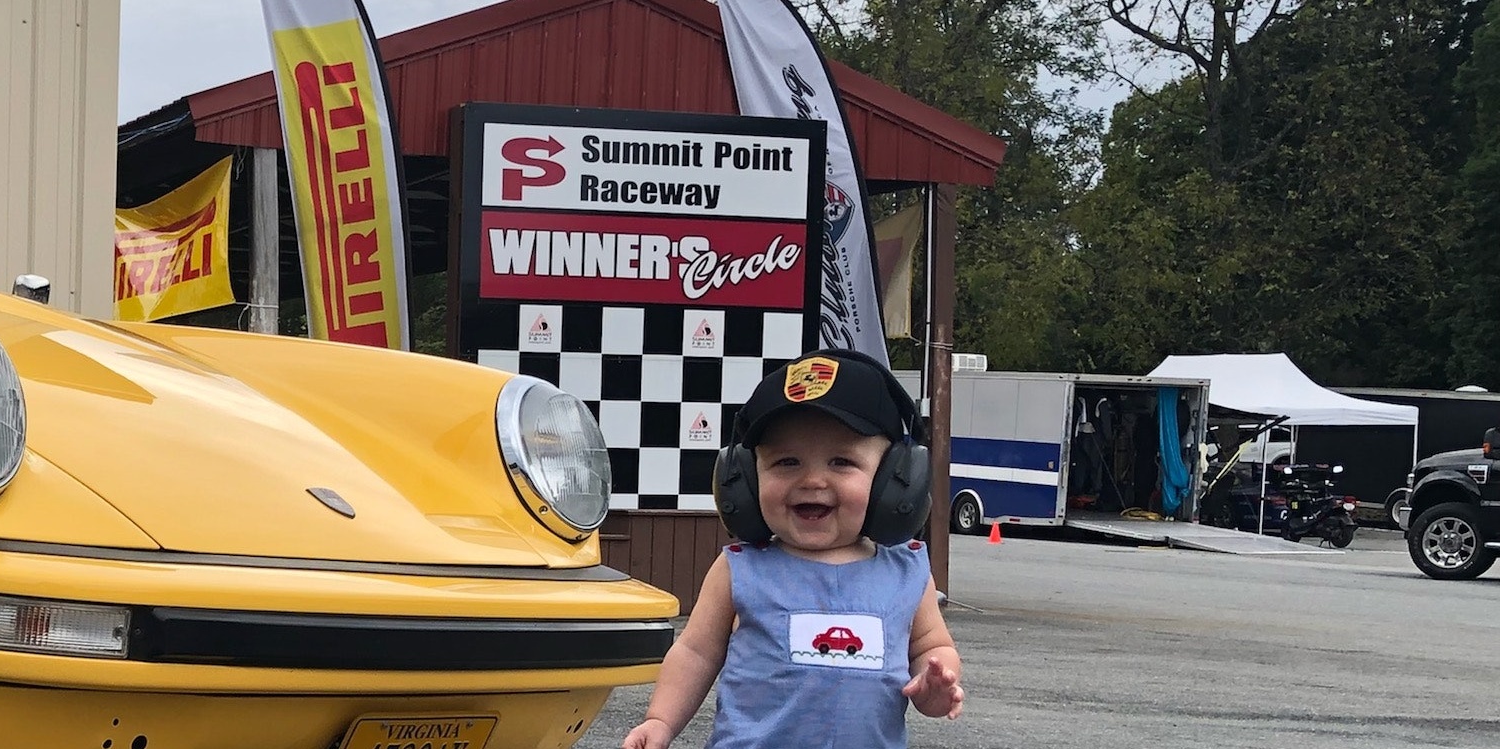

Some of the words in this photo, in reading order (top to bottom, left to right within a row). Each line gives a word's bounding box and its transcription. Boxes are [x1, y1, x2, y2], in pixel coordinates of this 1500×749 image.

[581, 134, 703, 168] Summit
[713, 141, 793, 172] Point
[295, 61, 388, 348] PIRELLI
[580, 174, 721, 209] Raceway
[488, 228, 712, 281] WINNER'S
[681, 235, 801, 299] Circle
[841, 247, 851, 276] CLUB
[847, 281, 861, 333] PORSCHE
[387, 723, 460, 739] VIRGINIA
